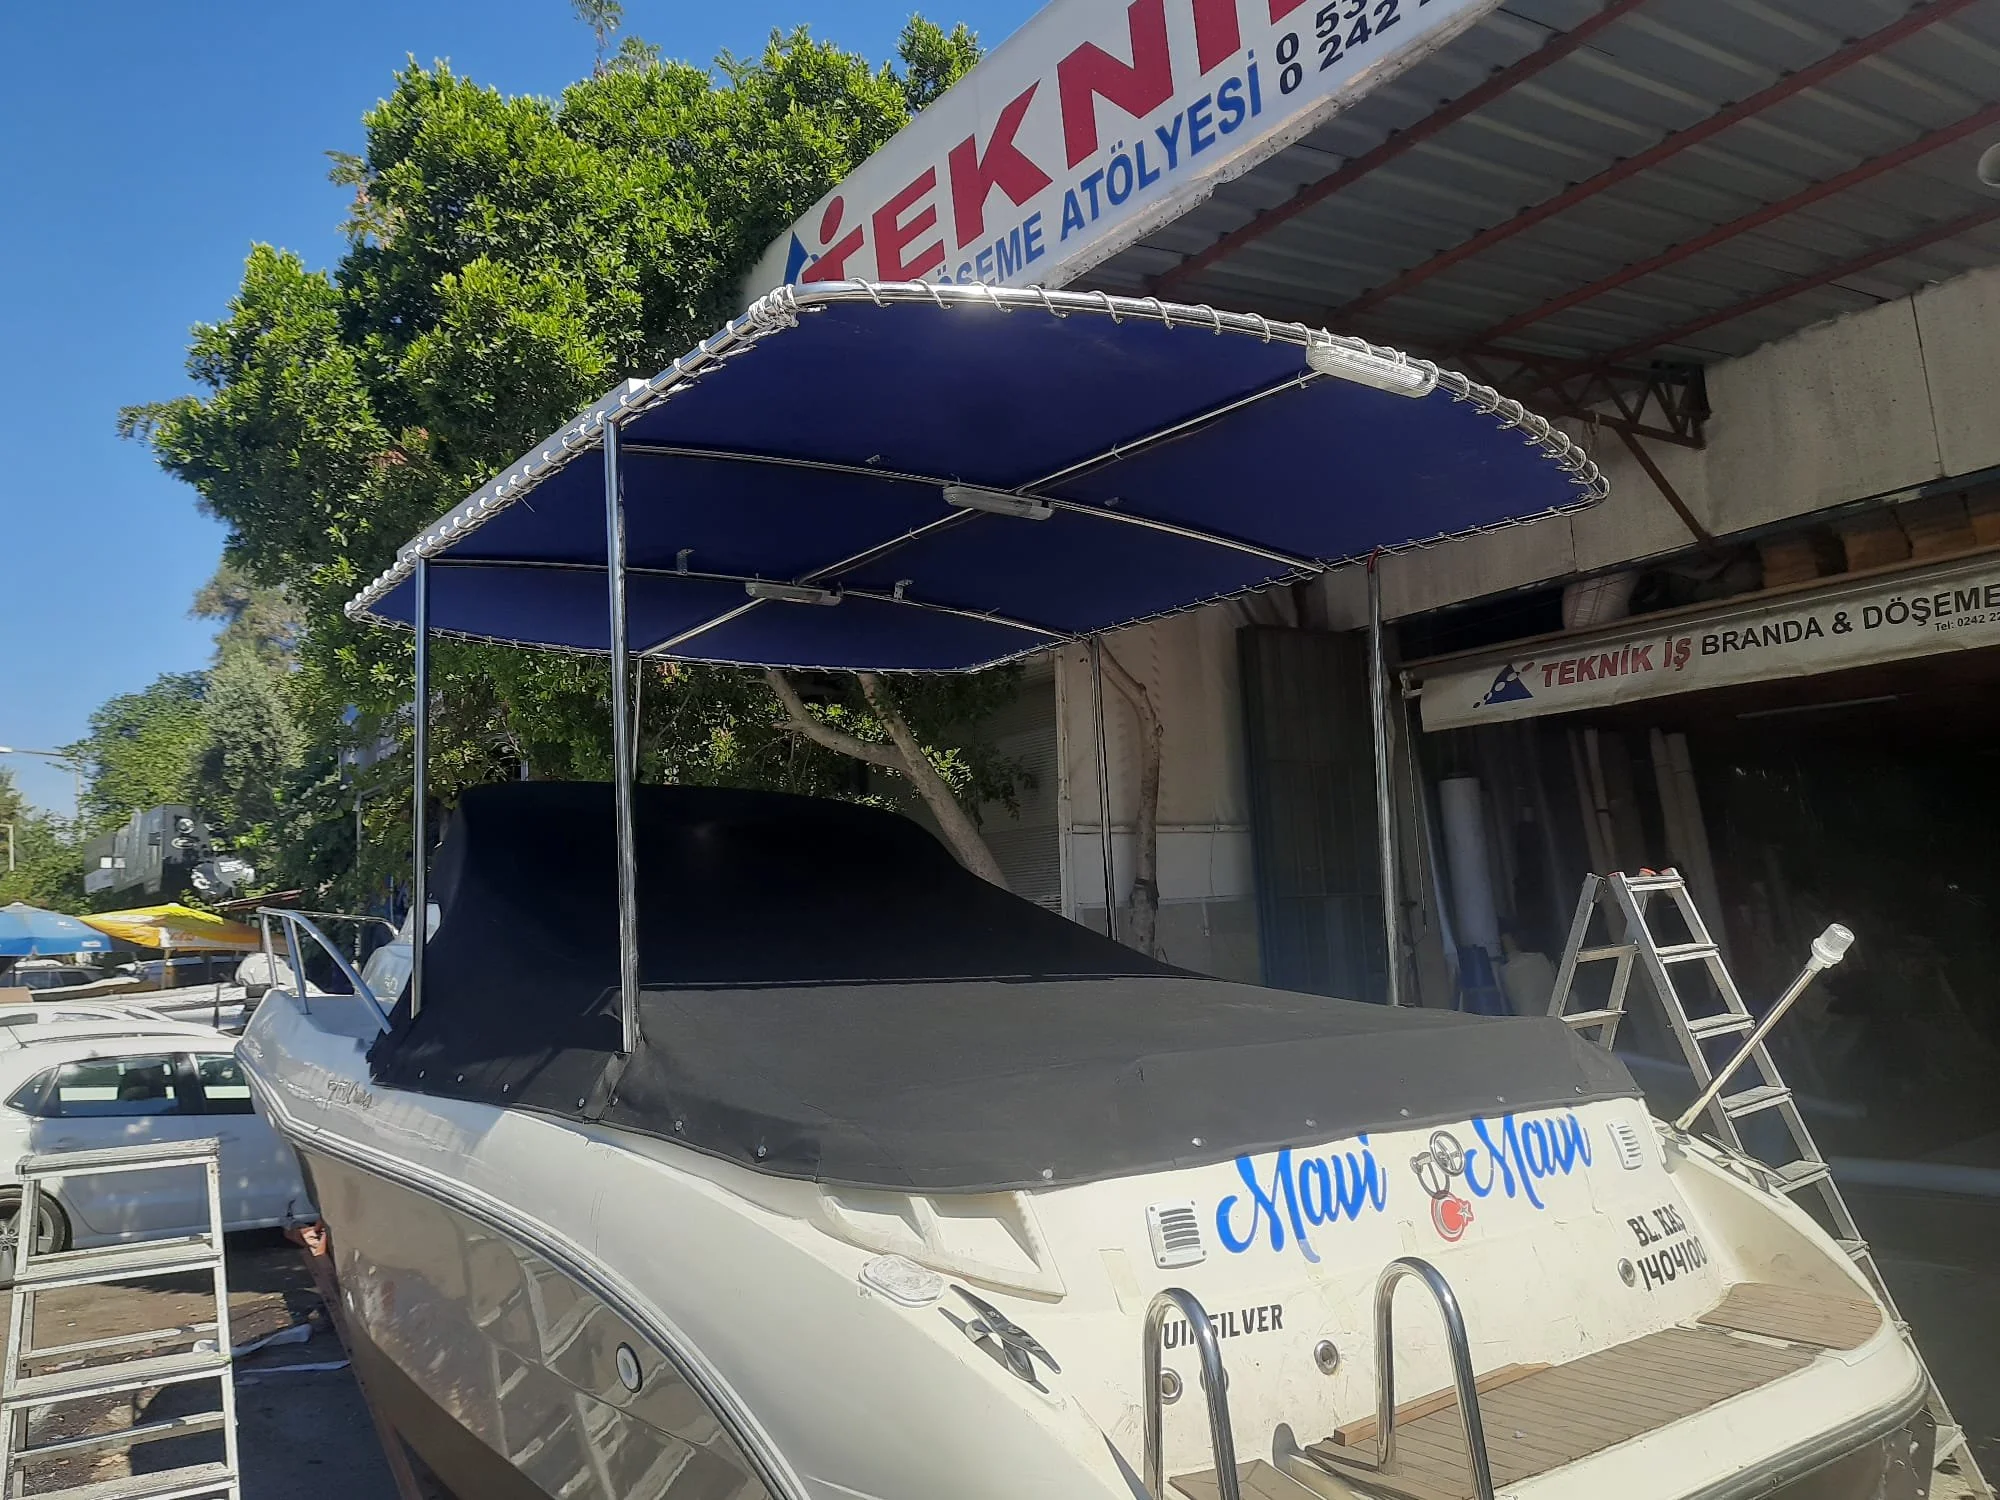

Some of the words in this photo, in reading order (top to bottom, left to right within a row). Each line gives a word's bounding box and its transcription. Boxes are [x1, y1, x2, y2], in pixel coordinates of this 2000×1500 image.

[1276, 32, 1300, 65] 0
[1279, 62, 1303, 95] 0
[1318, 0, 1401, 72] 242
[802, 0, 1306, 283] TEKN
[1059, 49, 1263, 242] ATÖLYESİ
[1541, 641, 1655, 688] TEKNİK
[1663, 635, 1692, 672] İŞ
[1701, 616, 1825, 656] BRANDA
[1831, 611, 1854, 635] &
[1862, 583, 2000, 630] DÖŞEME
[1933, 619, 1955, 632] Tel:
[1957, 614, 1986, 627] 0242
[1216, 1131, 1387, 1263] Mavi
[1464, 1112, 1592, 1210] Mavi
[1636, 1235, 1708, 1293] 1404100
